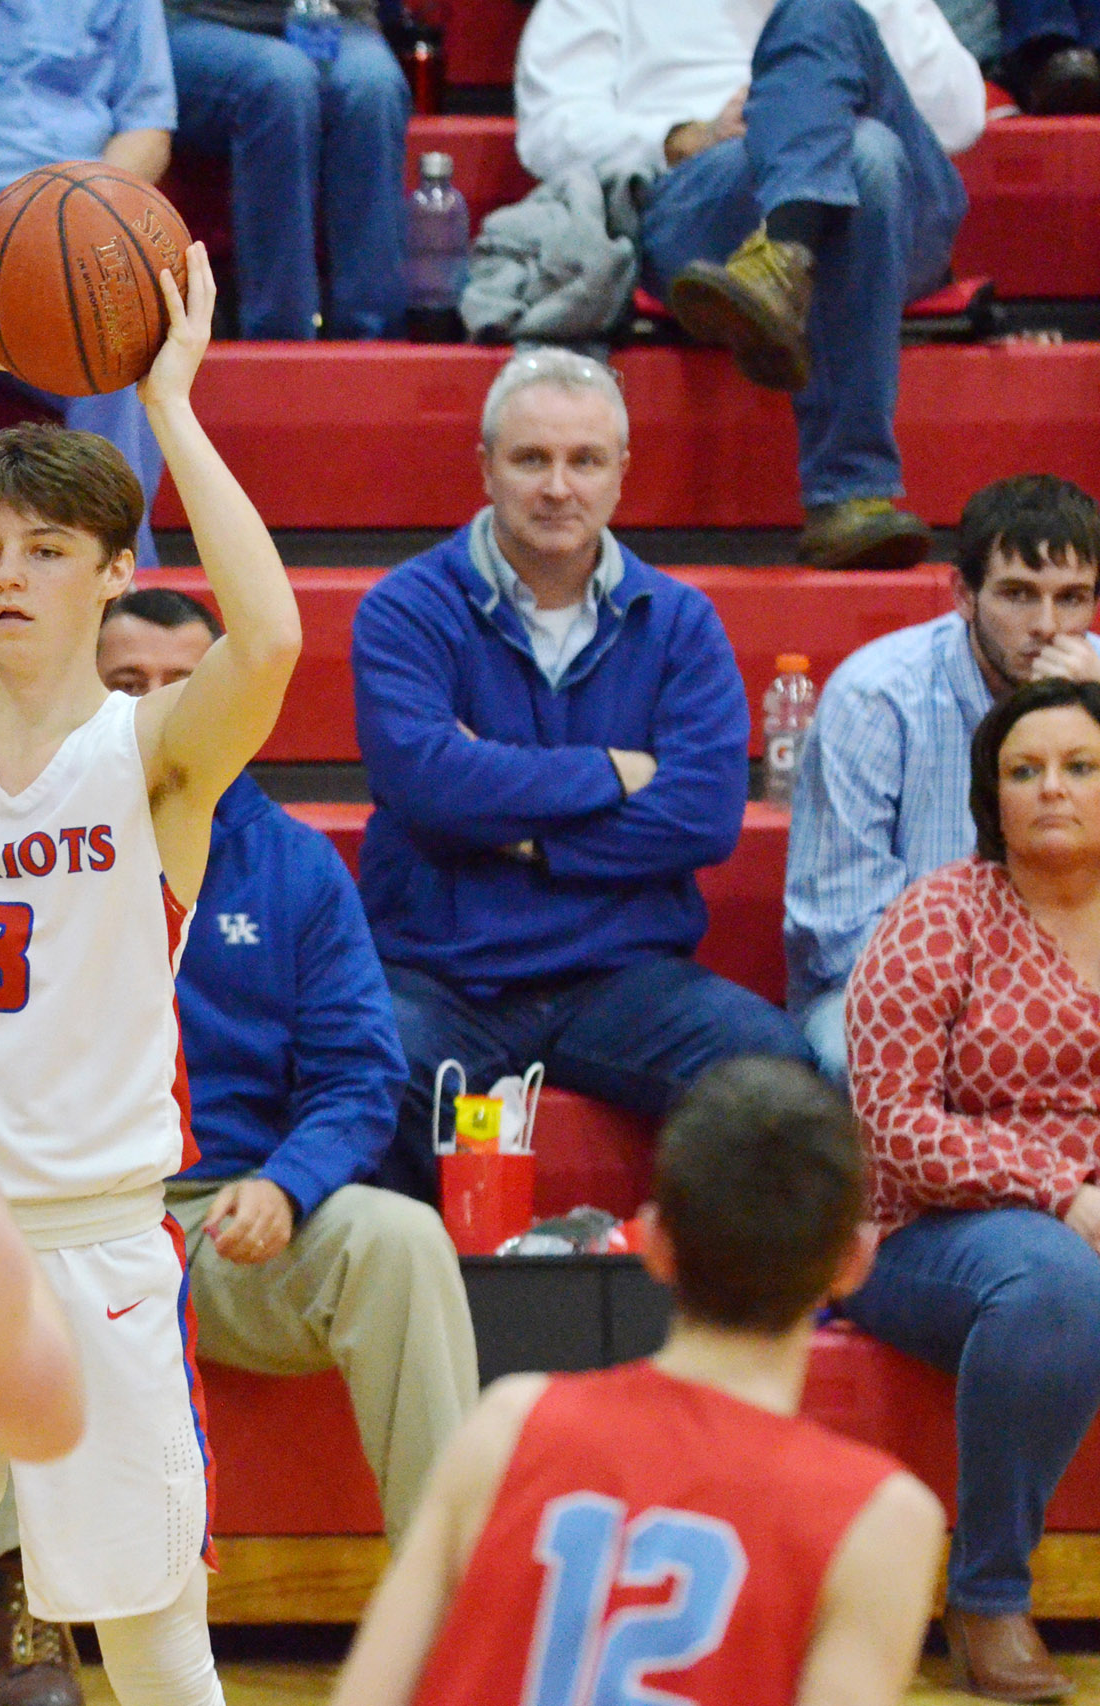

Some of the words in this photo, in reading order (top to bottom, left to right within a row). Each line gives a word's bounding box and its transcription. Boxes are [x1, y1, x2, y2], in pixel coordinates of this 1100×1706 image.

[769, 736, 795, 771] G
[217, 912, 260, 945] UK
[518, 1490, 749, 1706] 12
